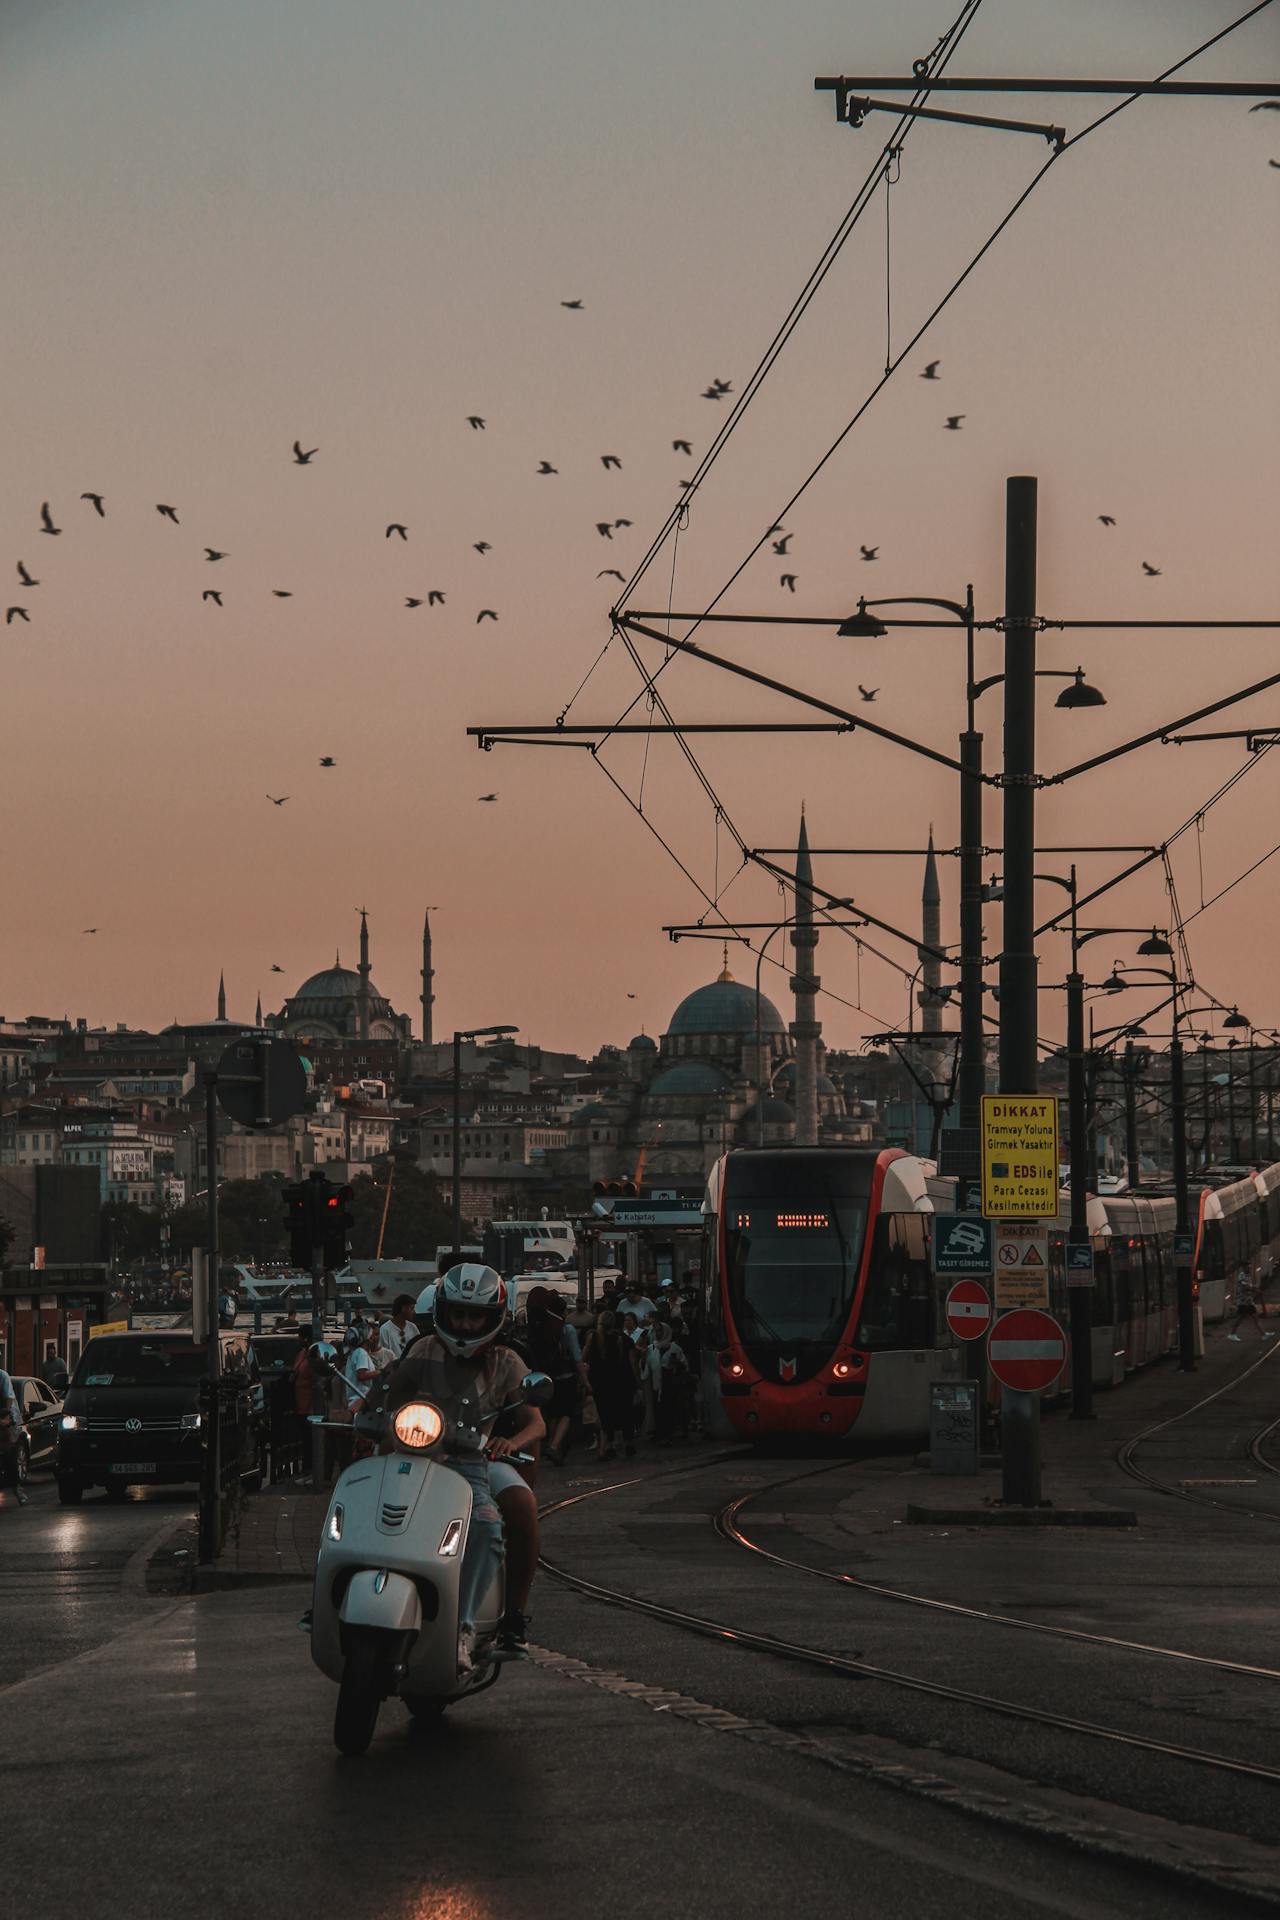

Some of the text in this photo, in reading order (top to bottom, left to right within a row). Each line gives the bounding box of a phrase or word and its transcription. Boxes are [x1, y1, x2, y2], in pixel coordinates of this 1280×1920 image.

[993, 1104, 1047, 1117] DİKKAT
[987, 1124, 1053, 1137] Tramvay Yoluna
[988, 1139, 1018, 1149] Girmek
[1014, 1165, 1053, 1179] EDS ile
[993, 1185, 1015, 1195] Para
[988, 1200, 1054, 1211] Kesilmektedir
[624, 1213, 656, 1222] Kabataş
